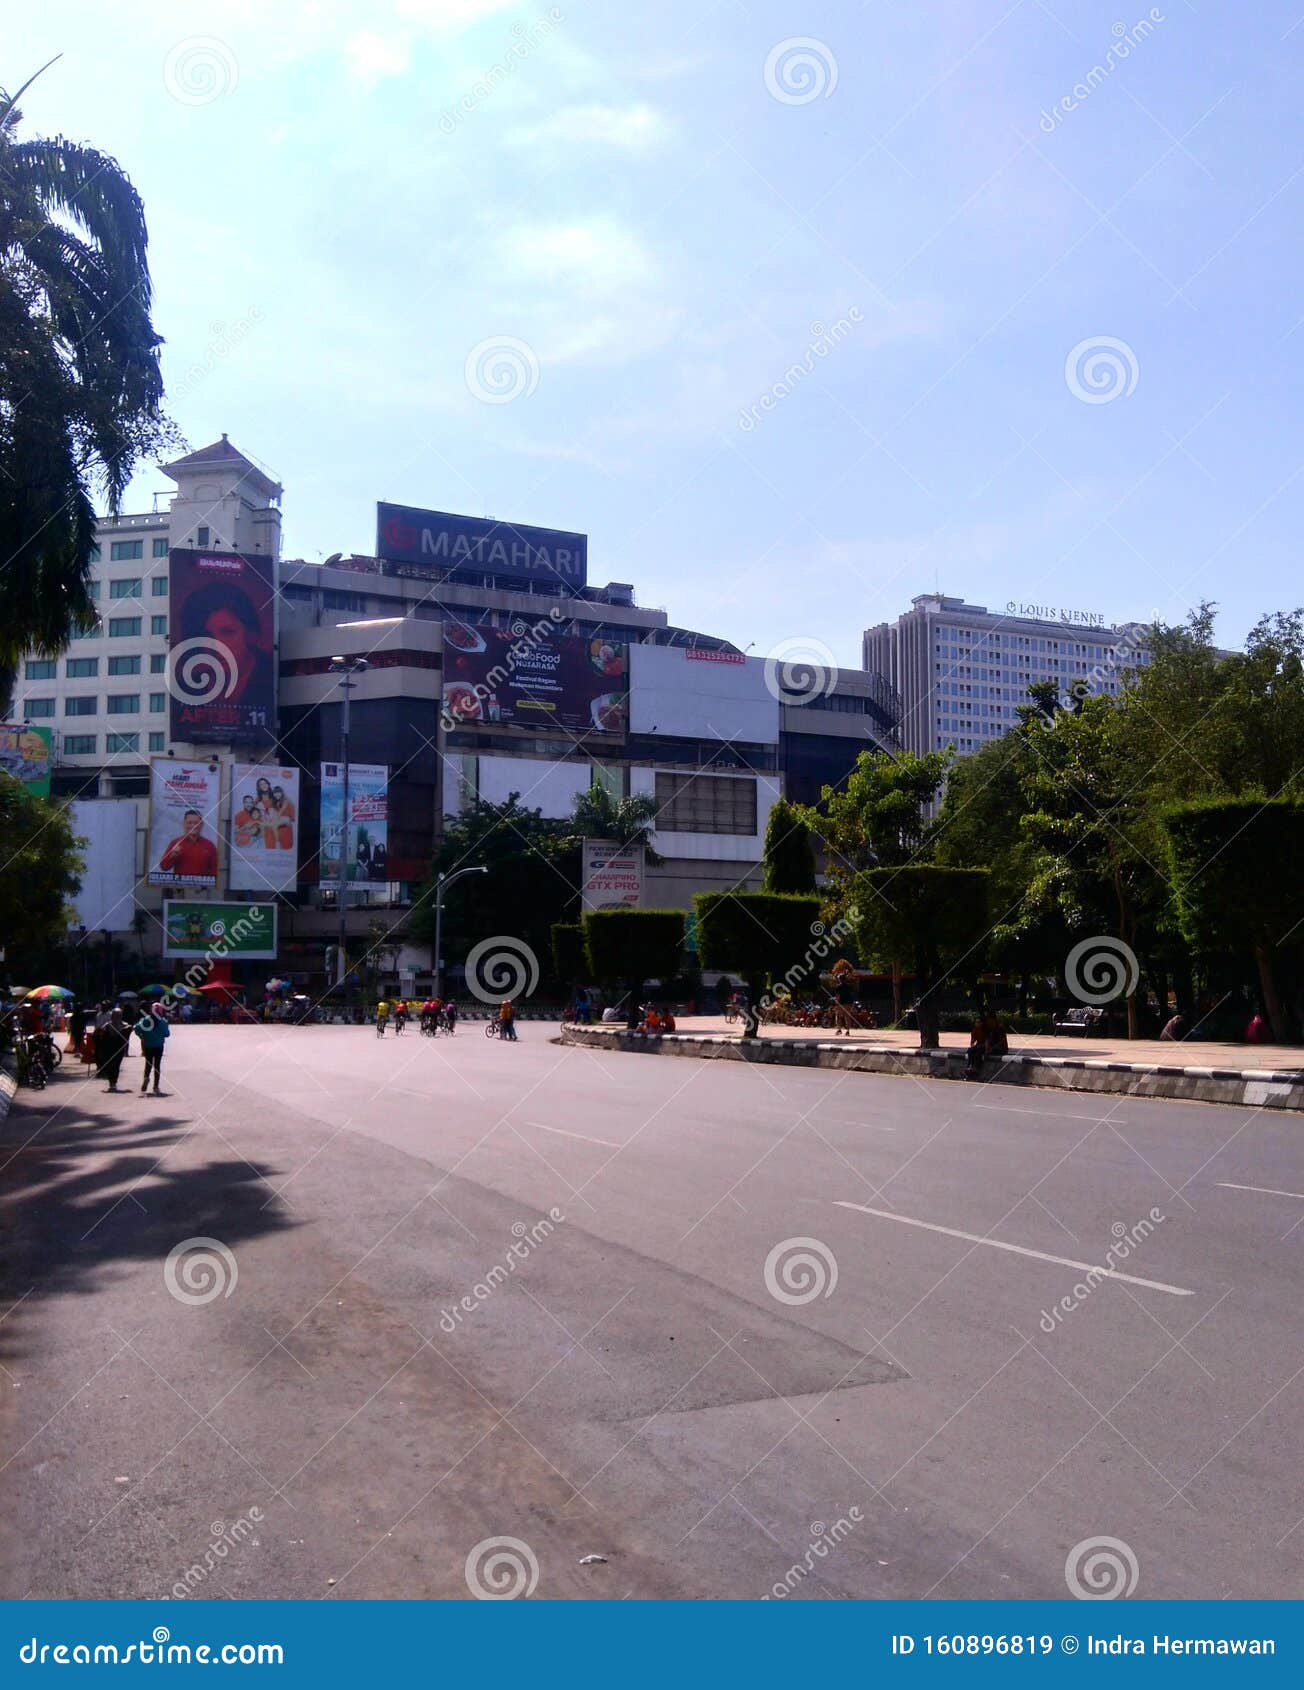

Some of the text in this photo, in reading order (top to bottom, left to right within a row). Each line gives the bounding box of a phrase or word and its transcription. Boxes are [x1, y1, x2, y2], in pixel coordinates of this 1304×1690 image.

[421, 528, 581, 575] MATAHARI
[1020, 603, 1104, 624] LOUIS KIENNE
[587, 882, 640, 890] GTX PRO
